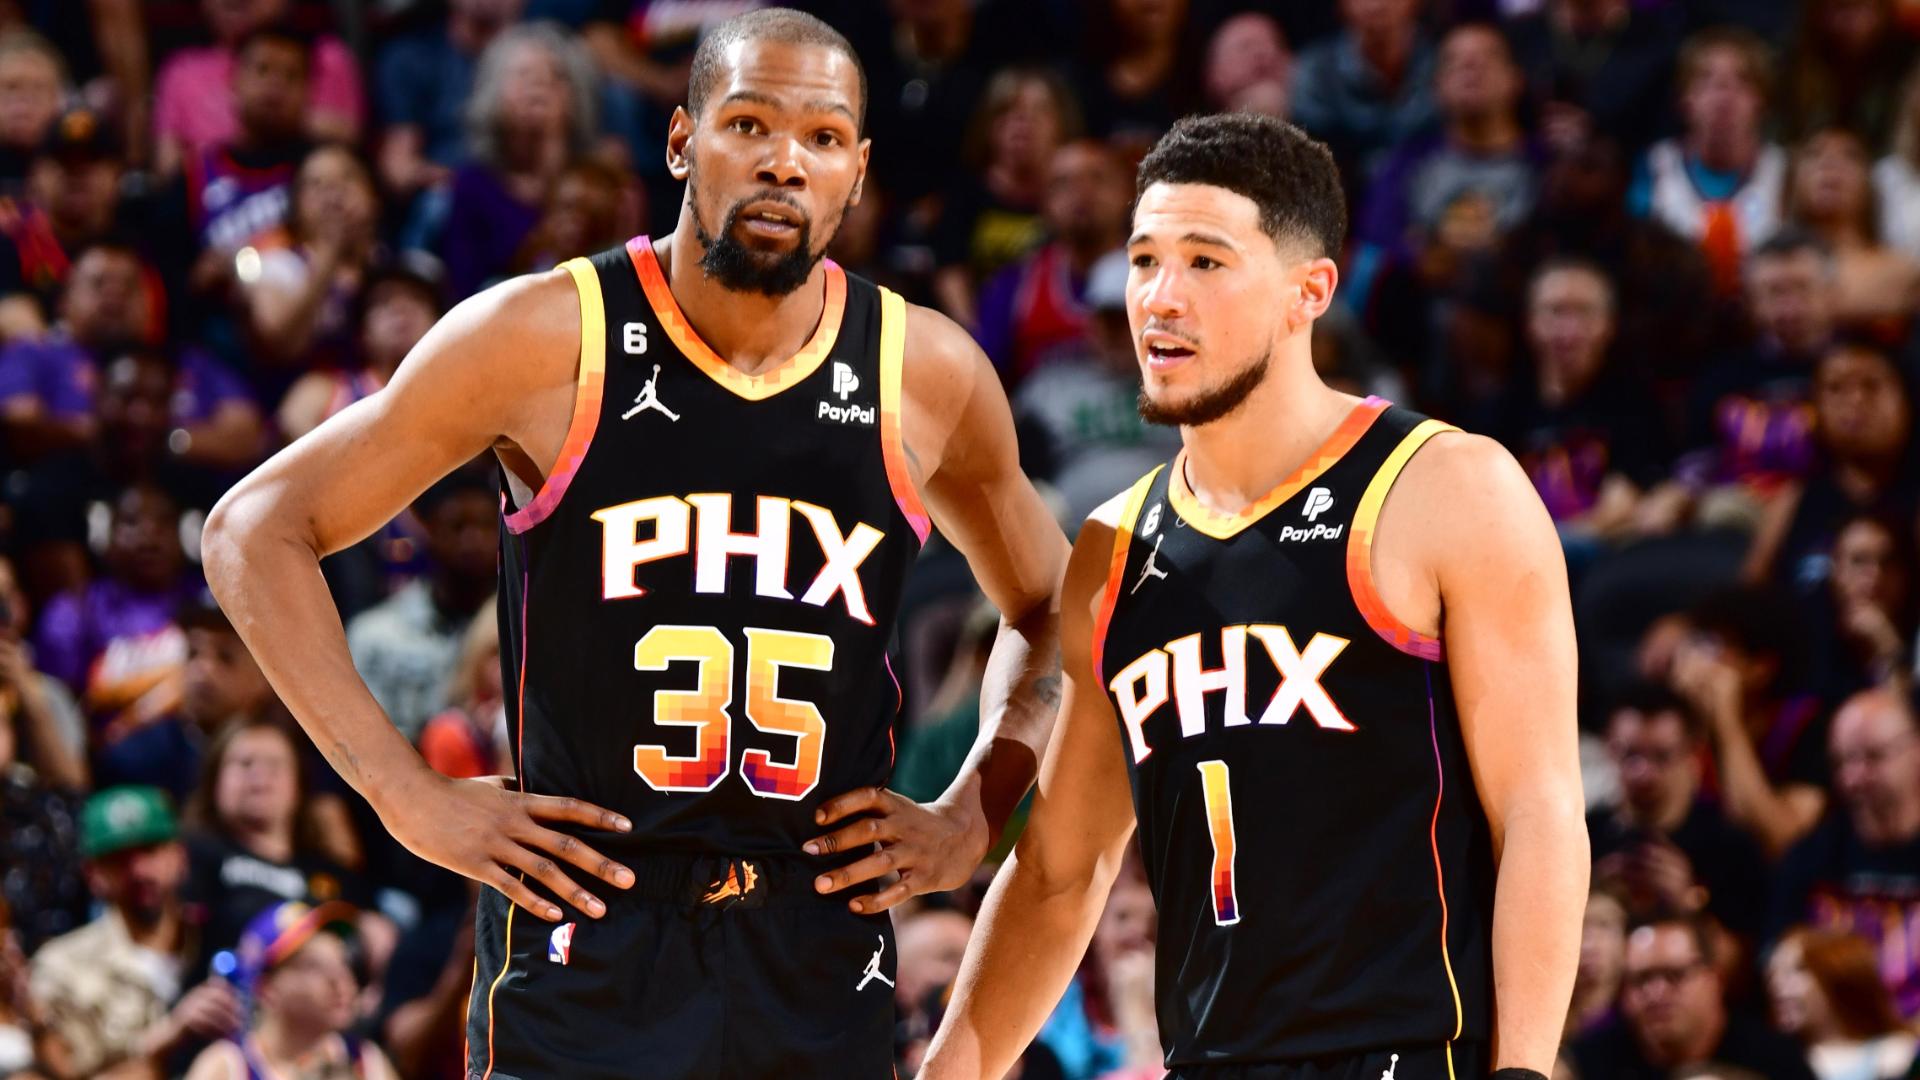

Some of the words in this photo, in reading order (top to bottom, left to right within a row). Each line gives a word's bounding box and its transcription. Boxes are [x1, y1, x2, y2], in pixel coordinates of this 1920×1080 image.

[623, 322, 648, 354] 6
[818, 401, 875, 424] PayPal
[590, 493, 886, 626] PHX
[1141, 503, 1163, 538] 6
[1279, 524, 1344, 543] PayPal
[634, 624, 835, 801] 35
[1109, 624, 1360, 766] PHX
[1196, 759, 1241, 927] 1
